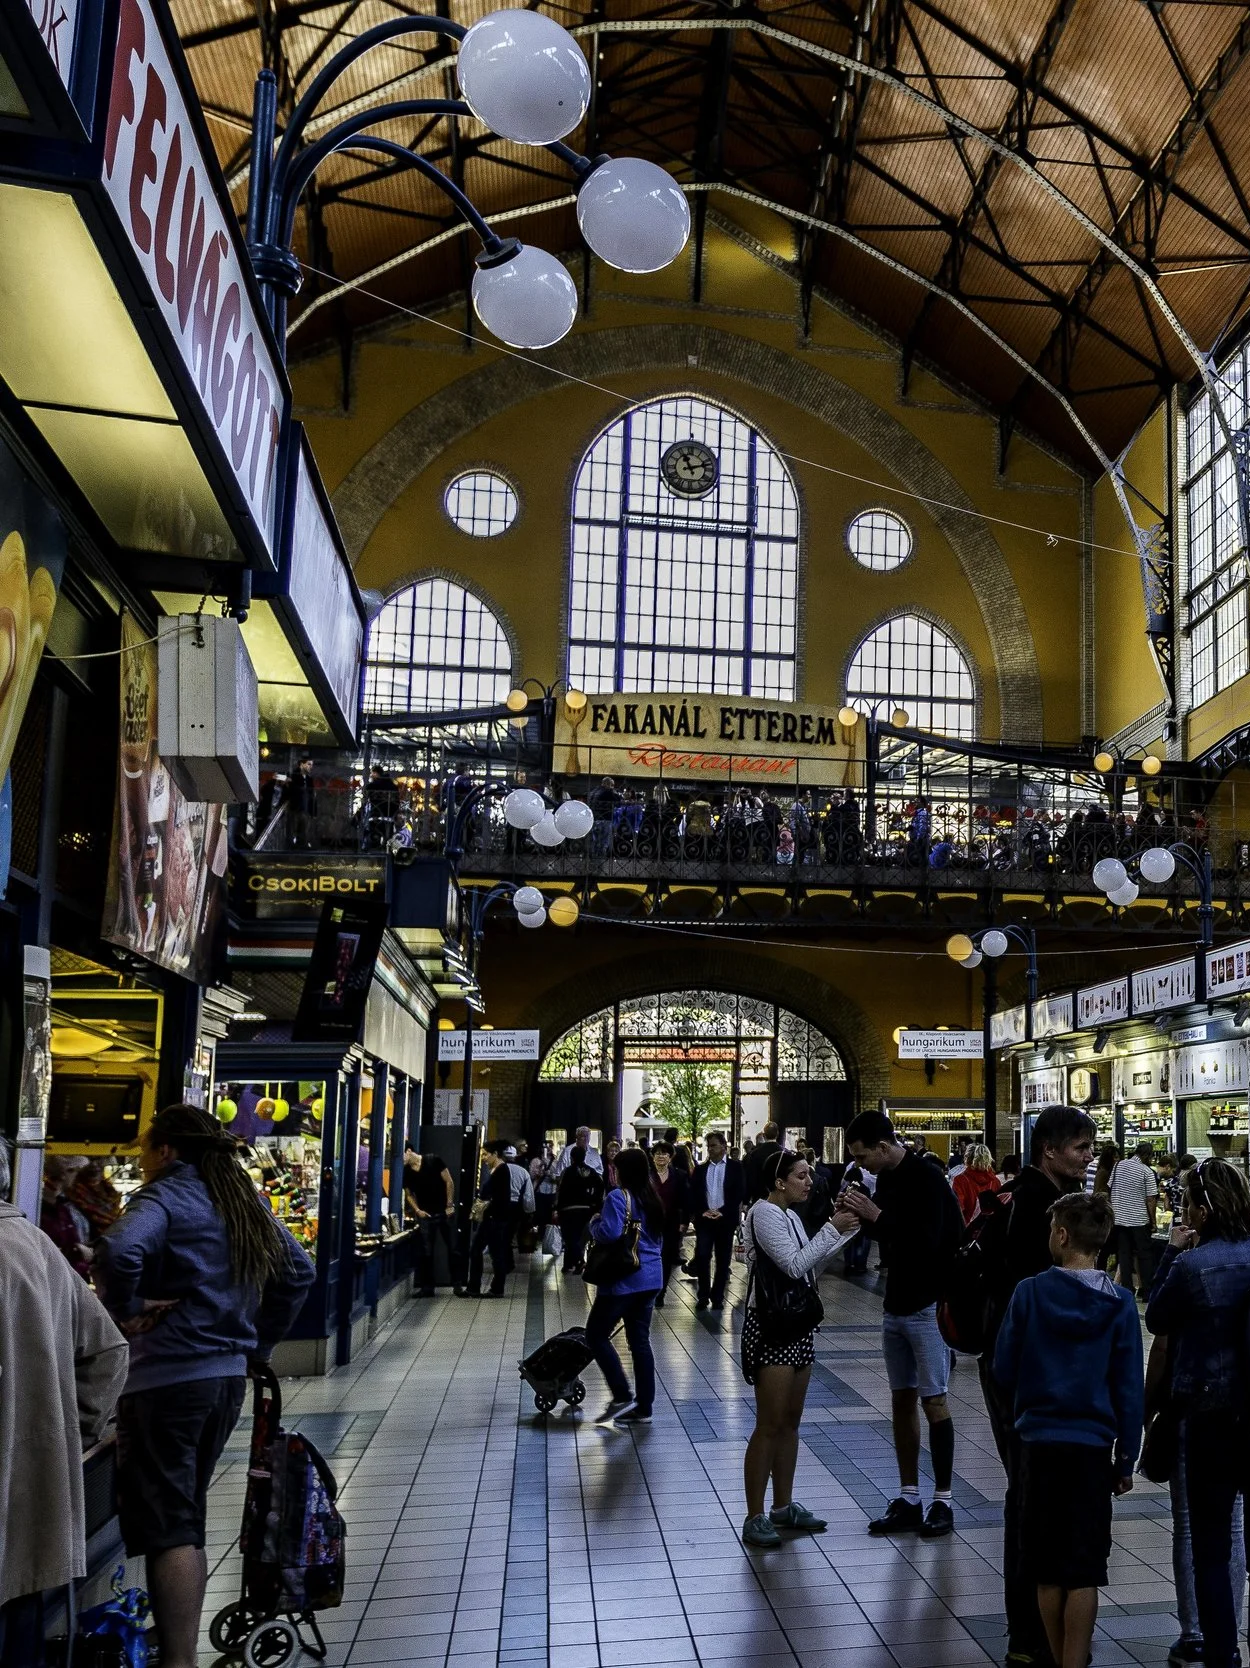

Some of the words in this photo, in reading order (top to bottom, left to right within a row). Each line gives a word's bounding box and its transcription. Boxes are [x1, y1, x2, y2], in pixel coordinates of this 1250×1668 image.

[102, 0, 279, 529] FELVÁGOTT
[591, 698, 706, 739] FAKANÁL
[718, 706, 837, 746] ETTEREM
[627, 743, 798, 775] Restaurant
[441, 1036, 516, 1047] hunarikum
[902, 1036, 965, 1048] hungarikum
